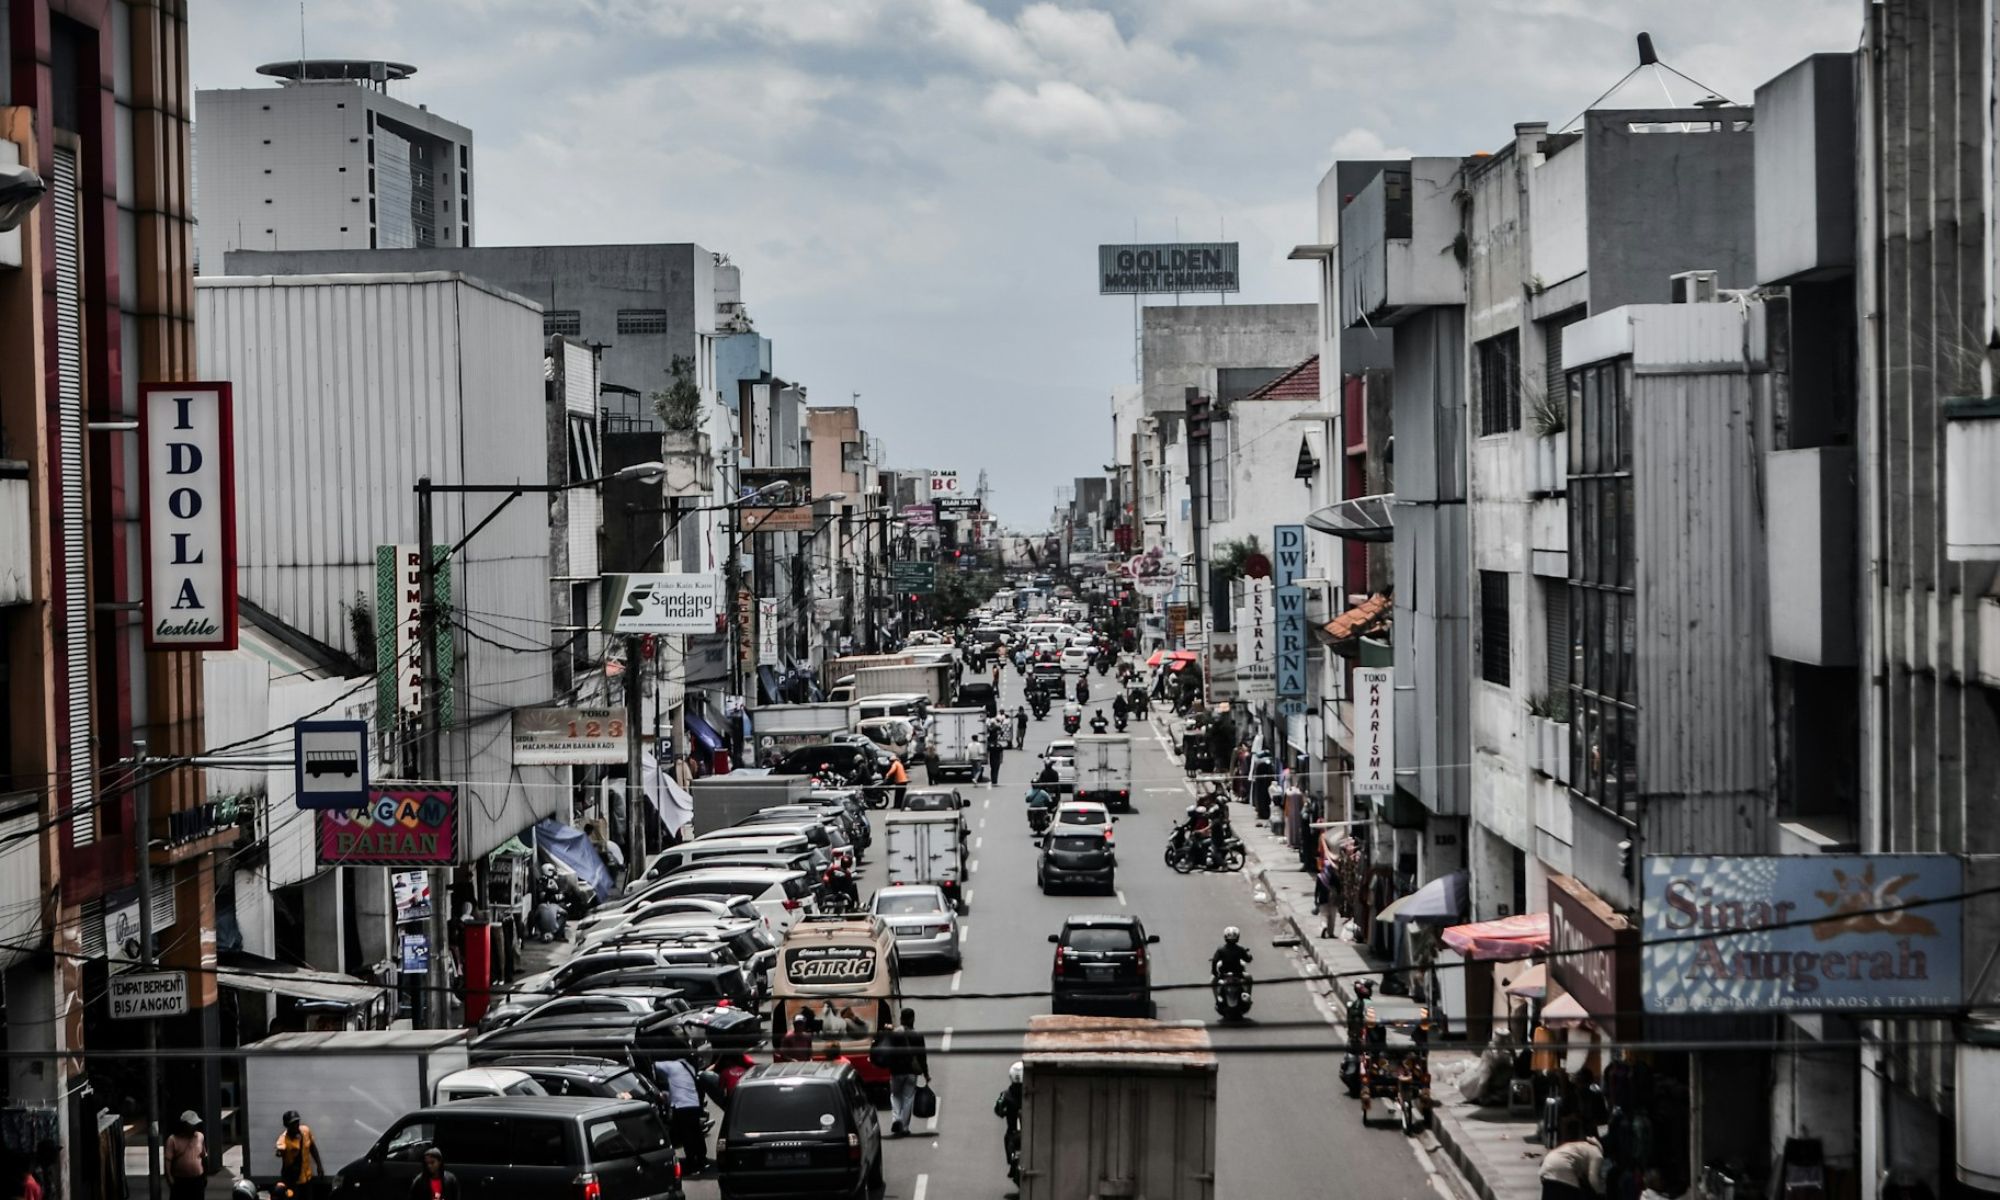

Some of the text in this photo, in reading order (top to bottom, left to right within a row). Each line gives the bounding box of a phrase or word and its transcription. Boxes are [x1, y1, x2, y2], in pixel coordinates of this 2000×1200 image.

[1117, 249, 1222, 271] GOLDEN
[1105, 273, 1159, 287] MONEY
[166, 398, 205, 609] IDOLA
[651, 592, 712, 609] Sandang
[665, 601, 704, 618] Indah
[1280, 531, 1300, 690] DWI WARNA
[156, 617, 219, 636] textile
[1254, 584, 1263, 662] CENTRAL
[1364, 674, 1387, 682] TOKO
[1284, 704, 1300, 713] 118
[1370, 684, 1380, 780] KHARISMA
[662, 740, 671, 753] P
[336, 832, 440, 854] BAHAN
[1665, 879, 1796, 930] Sinar
[790, 958, 874, 978] SATRIA
[1686, 936, 1928, 993] Anugerah
[113, 979, 183, 996] TEMPAT BERHENTI
[1826, 997, 1868, 1007] KAOS
